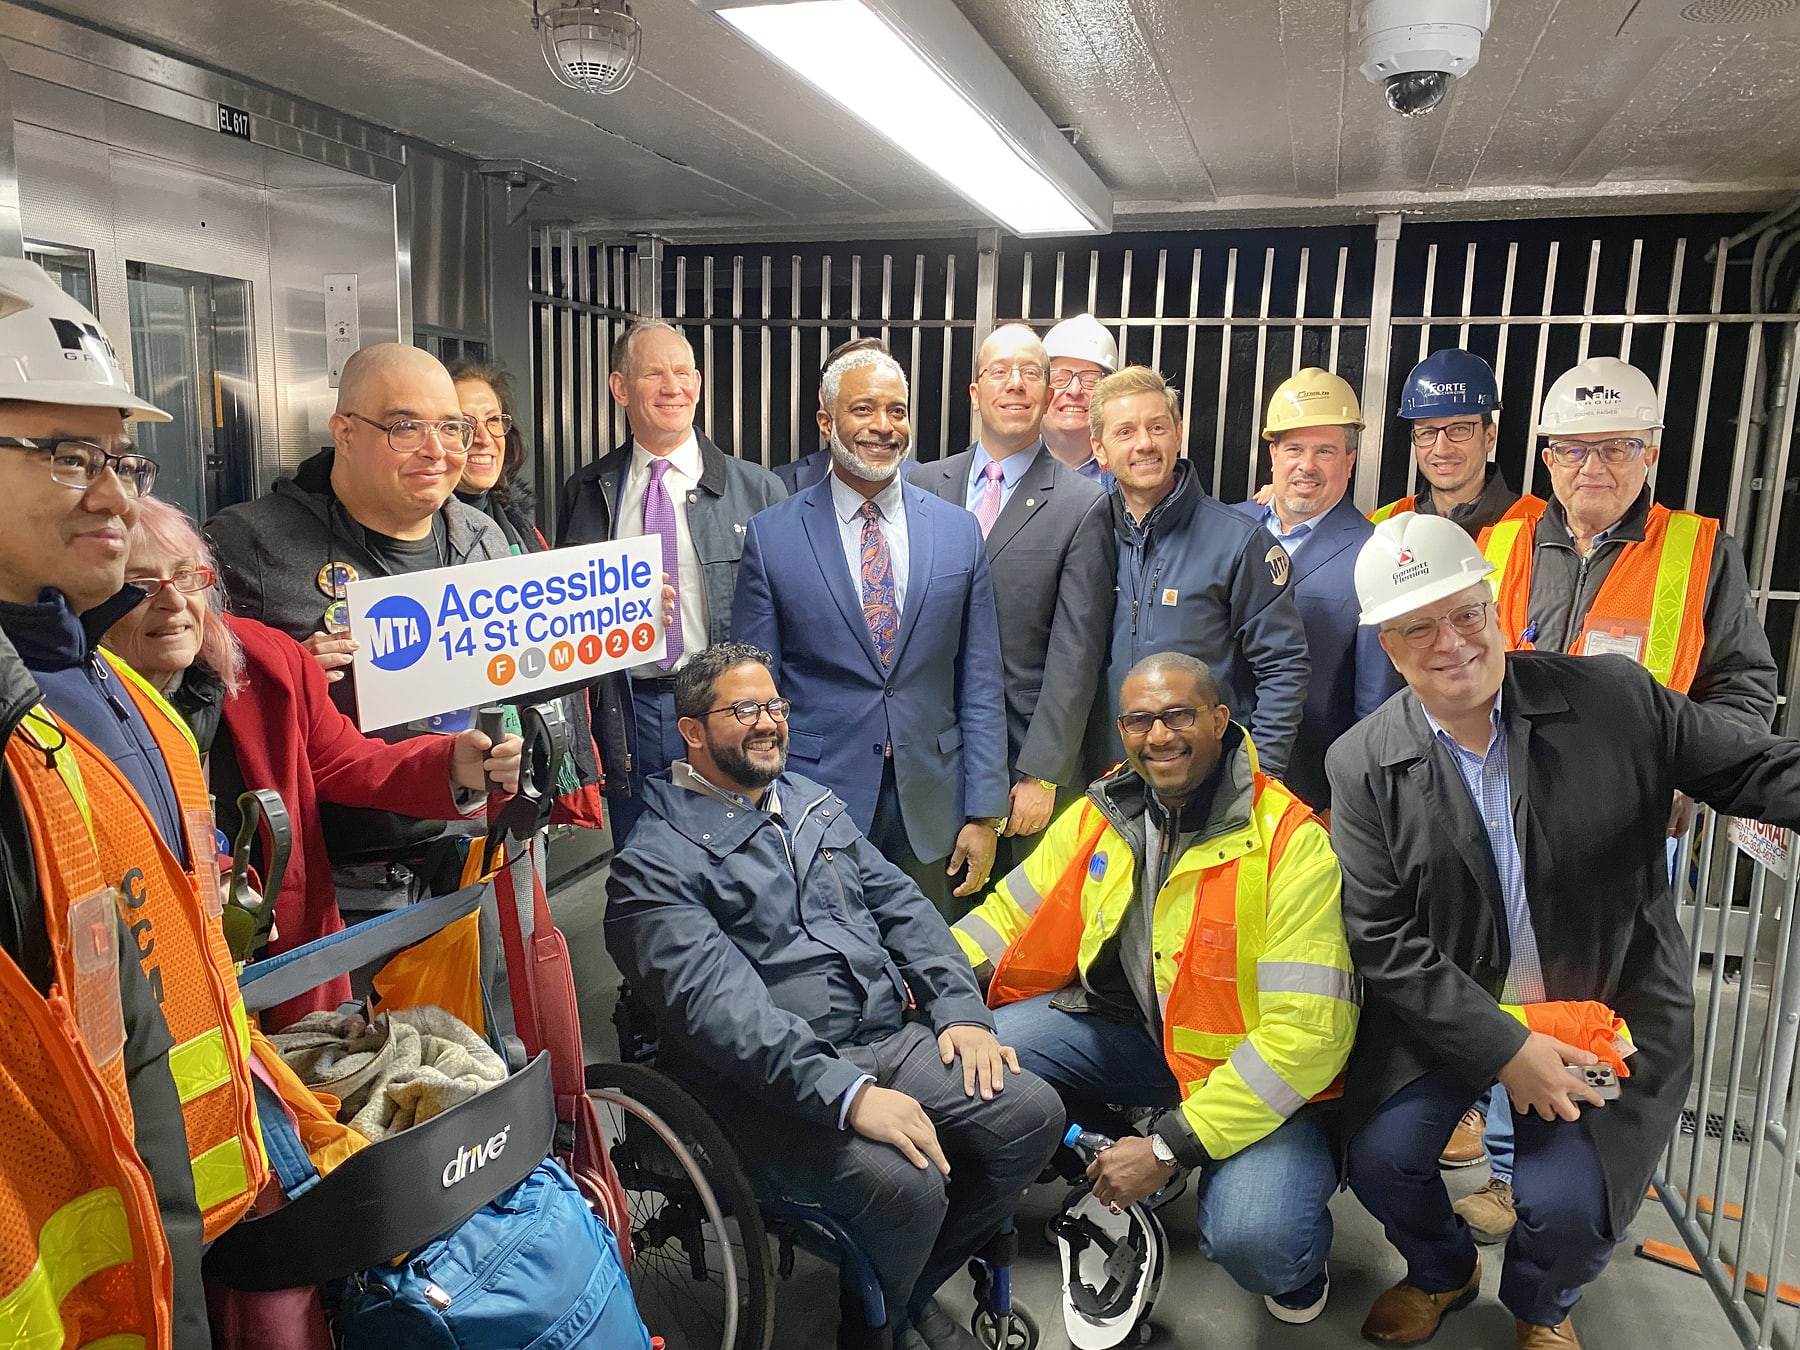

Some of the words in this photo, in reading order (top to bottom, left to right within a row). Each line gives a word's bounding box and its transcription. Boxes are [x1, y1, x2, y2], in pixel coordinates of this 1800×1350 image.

[220, 107, 232, 131] EL
[233, 112, 248, 136] 617
[1430, 382, 1467, 393] FORTE
[1392, 561, 1428, 580] Gannett
[1394, 568, 1430, 585] Fleming
[436, 554, 652, 627] Accessible
[364, 617, 422, 661] MTA
[438, 624, 477, 661] 14
[484, 619, 519, 652] St
[525, 597, 654, 643] Complex
